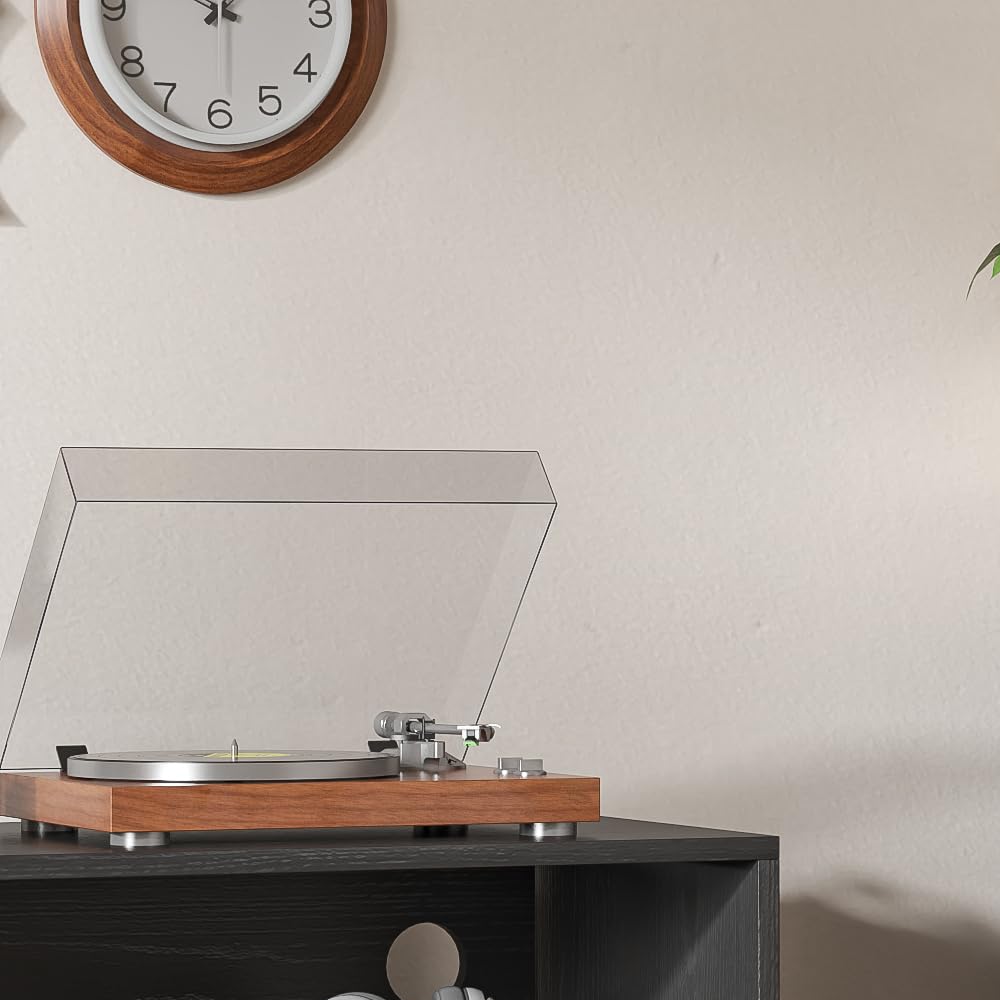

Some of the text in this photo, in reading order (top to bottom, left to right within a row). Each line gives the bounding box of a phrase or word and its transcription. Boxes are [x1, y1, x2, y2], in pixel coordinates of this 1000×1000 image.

[308, 0, 332, 28] 3
[120, 45, 144, 77] 8
[293, 52, 317, 83] 4
[154, 82, 177, 112] 7
[259, 86, 281, 115] 5
[207, 99, 232, 128] 6
